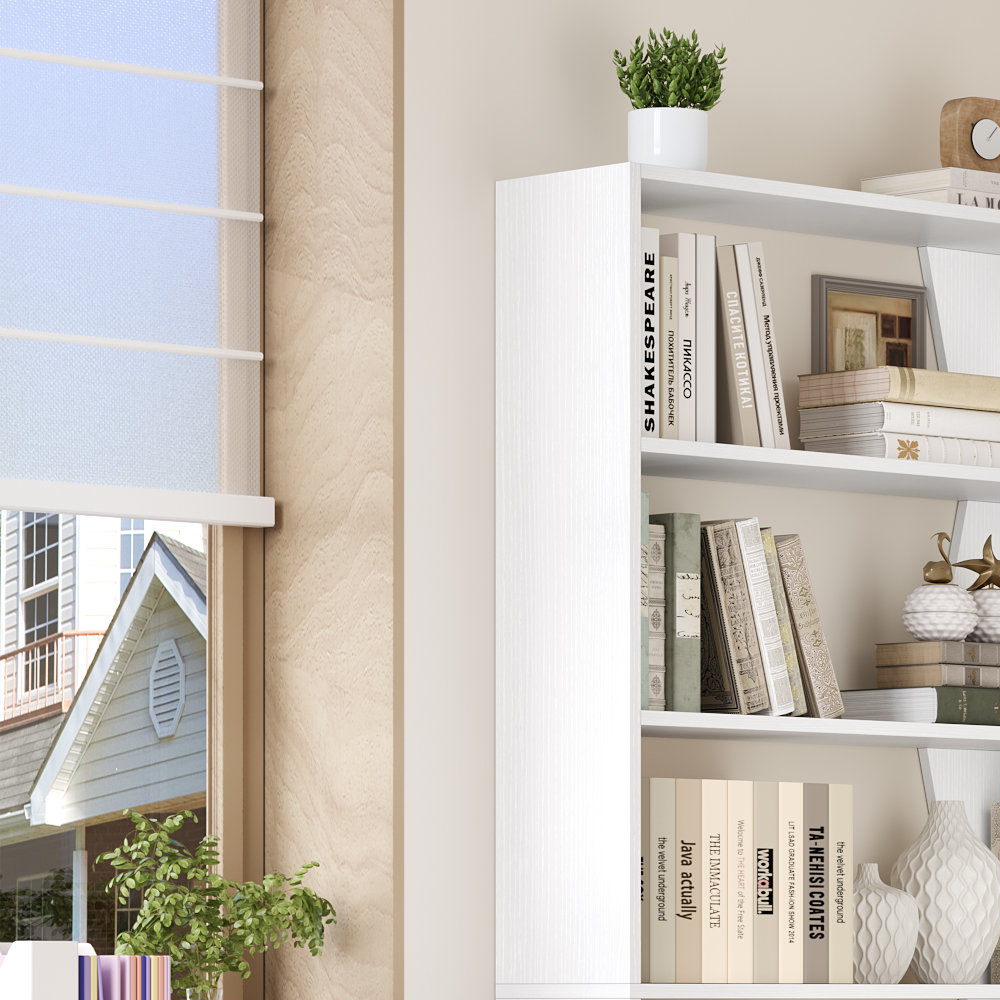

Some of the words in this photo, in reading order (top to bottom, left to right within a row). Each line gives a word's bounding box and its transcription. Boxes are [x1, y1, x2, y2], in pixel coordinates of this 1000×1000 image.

[957, 193, 979, 207] LA
[644, 251, 656, 433] SHAKESPEARE
[726, 291, 744, 349] СПАСИТЕ
[736, 353, 753, 409] КОТИКА!
[683, 339, 692, 399] ПИКАССО
[763, 315, 771, 340] Метод
[773, 392, 785, 435] проектами
[658, 837, 667, 849] the
[658, 851, 667, 873] velvet
[681, 840, 696, 866] Java
[709, 834, 720, 855] THE
[809, 827, 824, 888] TA-NEHISI
[837, 842, 845, 854] the
[837, 855, 845, 876] velvet
[656, 874, 667, 921] underground
[676, 872, 696, 920] actually
[709, 858, 720, 928] IMMACULATE
[758, 849, 773, 914] workabull.
[835, 878, 845, 923] underground
[809, 891, 824, 939] COATES
